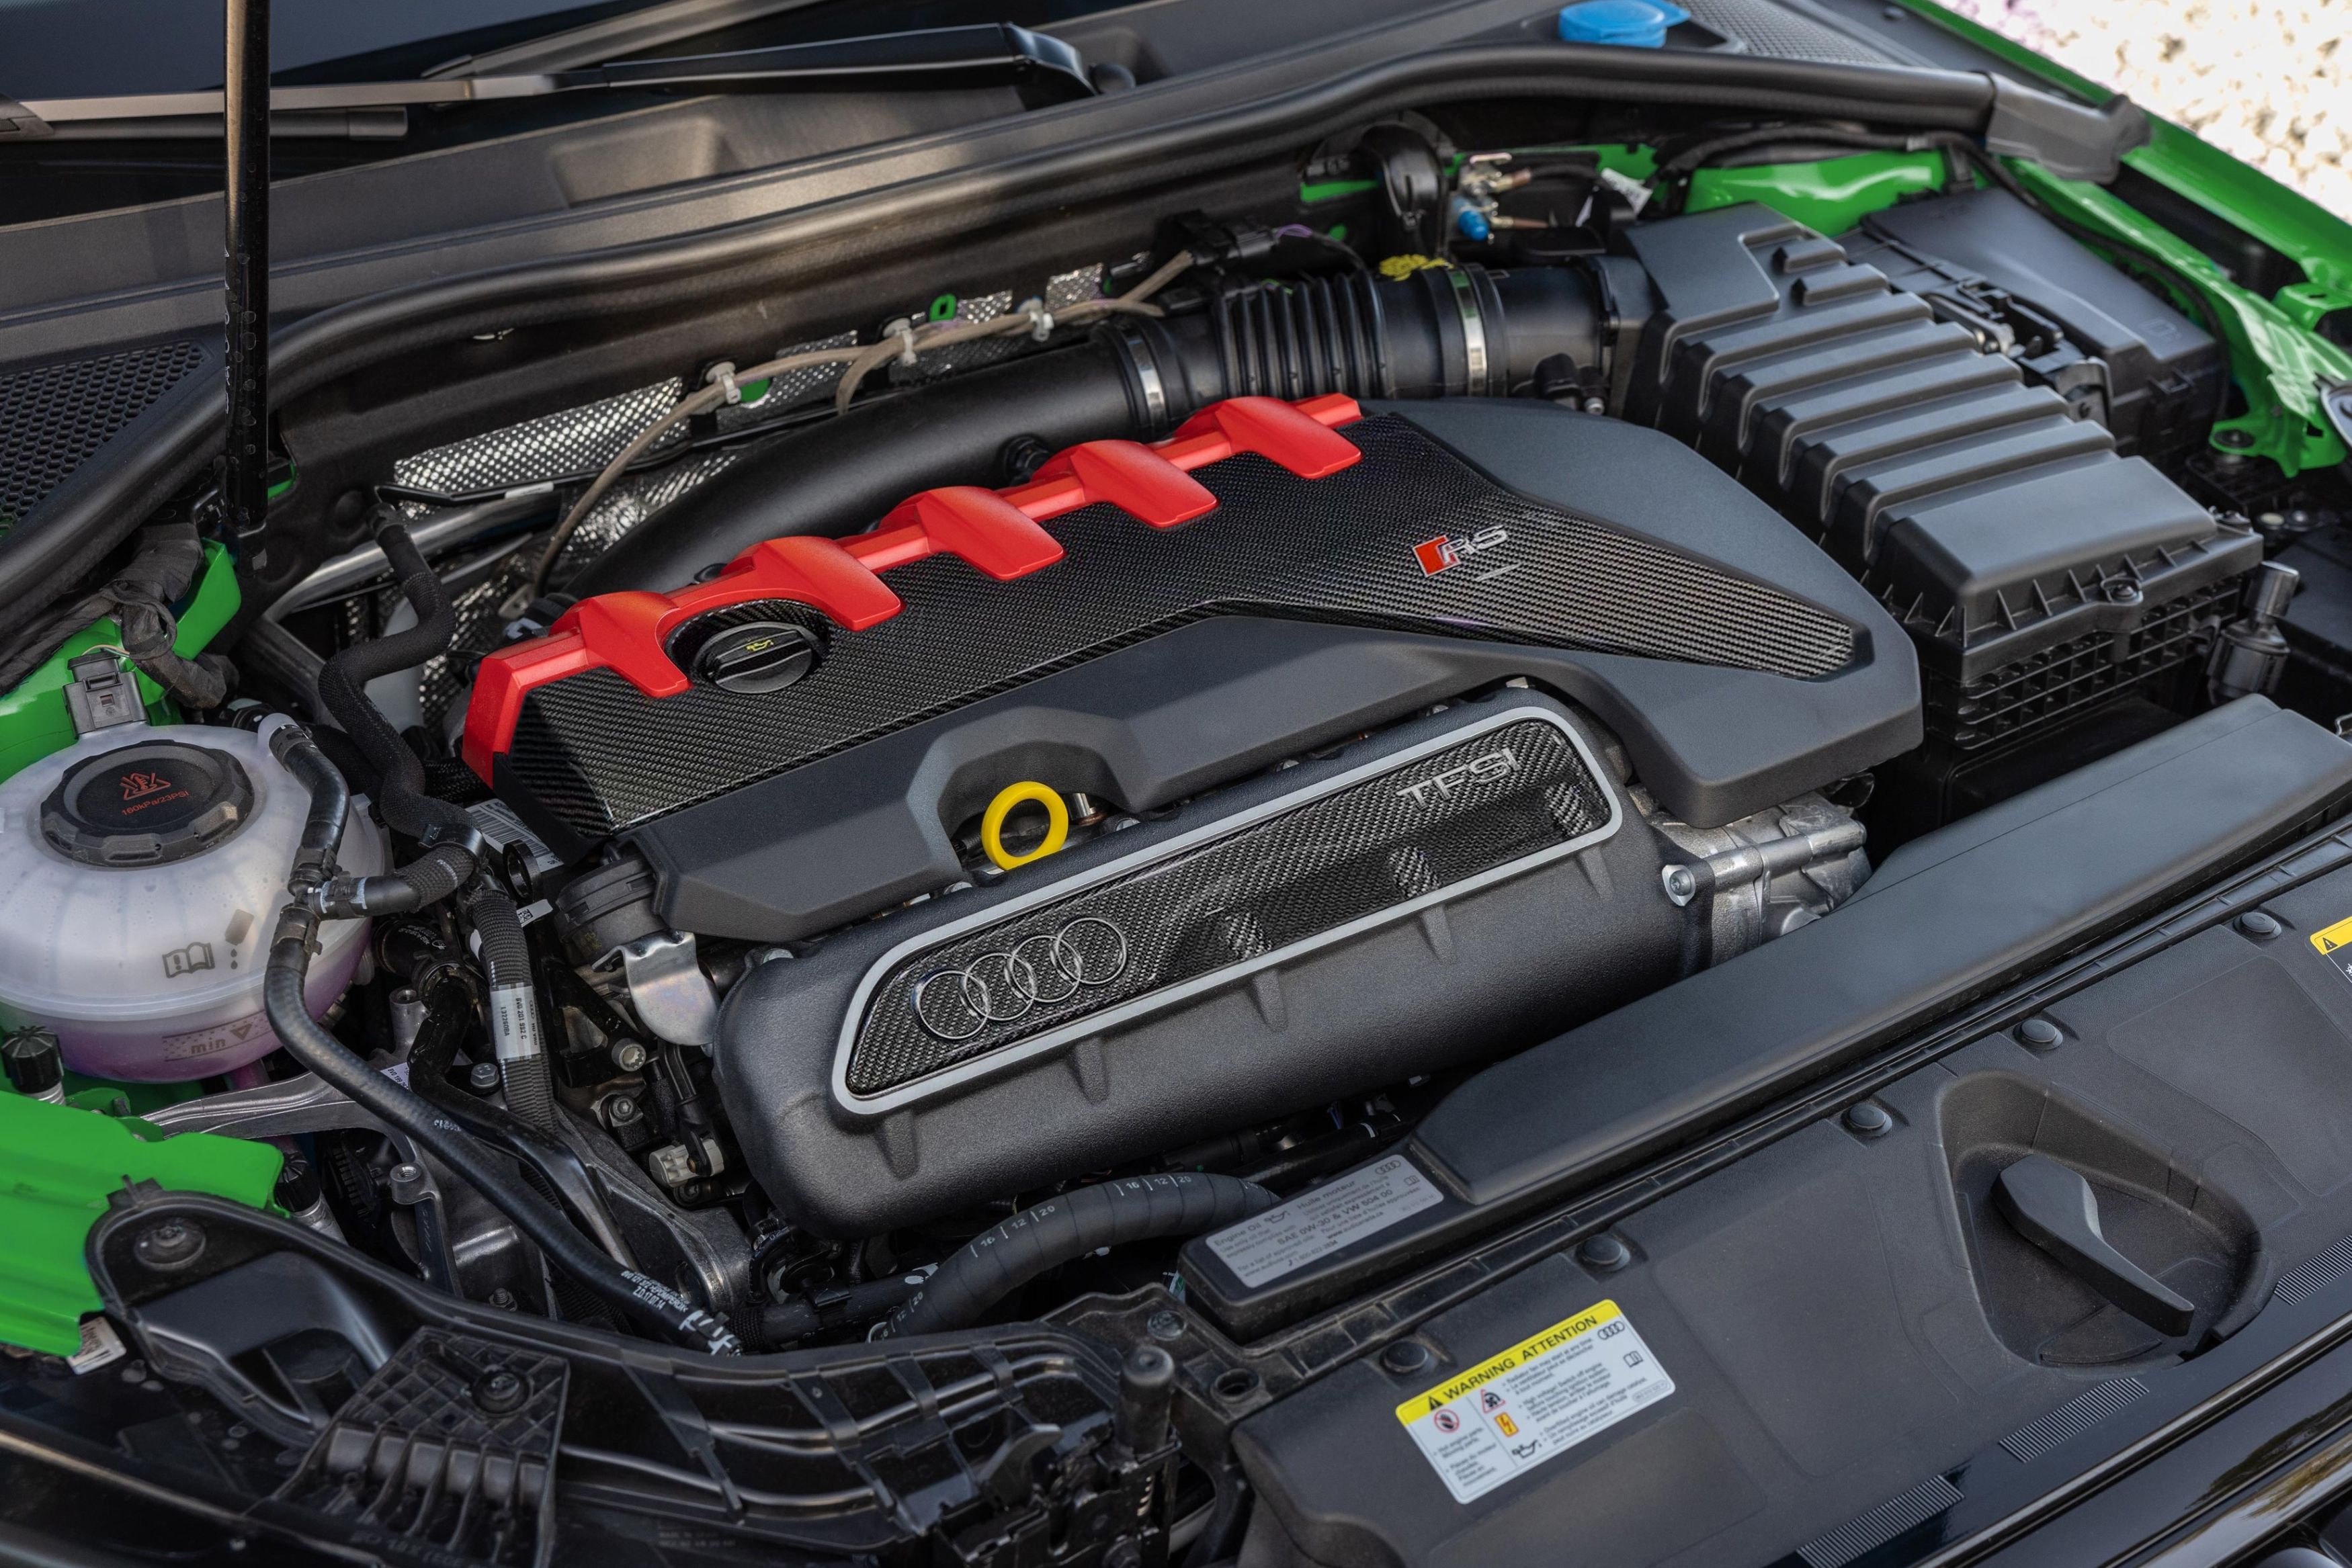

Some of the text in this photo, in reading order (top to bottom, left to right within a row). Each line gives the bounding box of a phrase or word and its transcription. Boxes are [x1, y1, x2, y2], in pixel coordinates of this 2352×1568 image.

[1441, 523, 1508, 564] RS
[1396, 747, 1523, 808] TFSI
[121, 789, 190, 816] 160kPa/23PSI
[191, 1039, 226, 1055] min
[1126, 1176, 1192, 1190] 16 12 20
[1296, 1180, 1355, 1209] Huile moteur
[1214, 1222, 1261, 1246] Engine Oil
[1277, 1232, 1298, 1245] SAE
[1341, 1203, 1360, 1215] VW
[1361, 1195, 1380, 1206] 504
[1380, 1189, 1393, 1198] 00
[912, 1291, 924, 1306] 20
[980, 1235, 995, 1248] 16
[1011, 1218, 1027, 1229] 12
[1039, 1205, 1056, 1217] 20
[1443, 1315, 1597, 1399] WARNING ATTENTION
